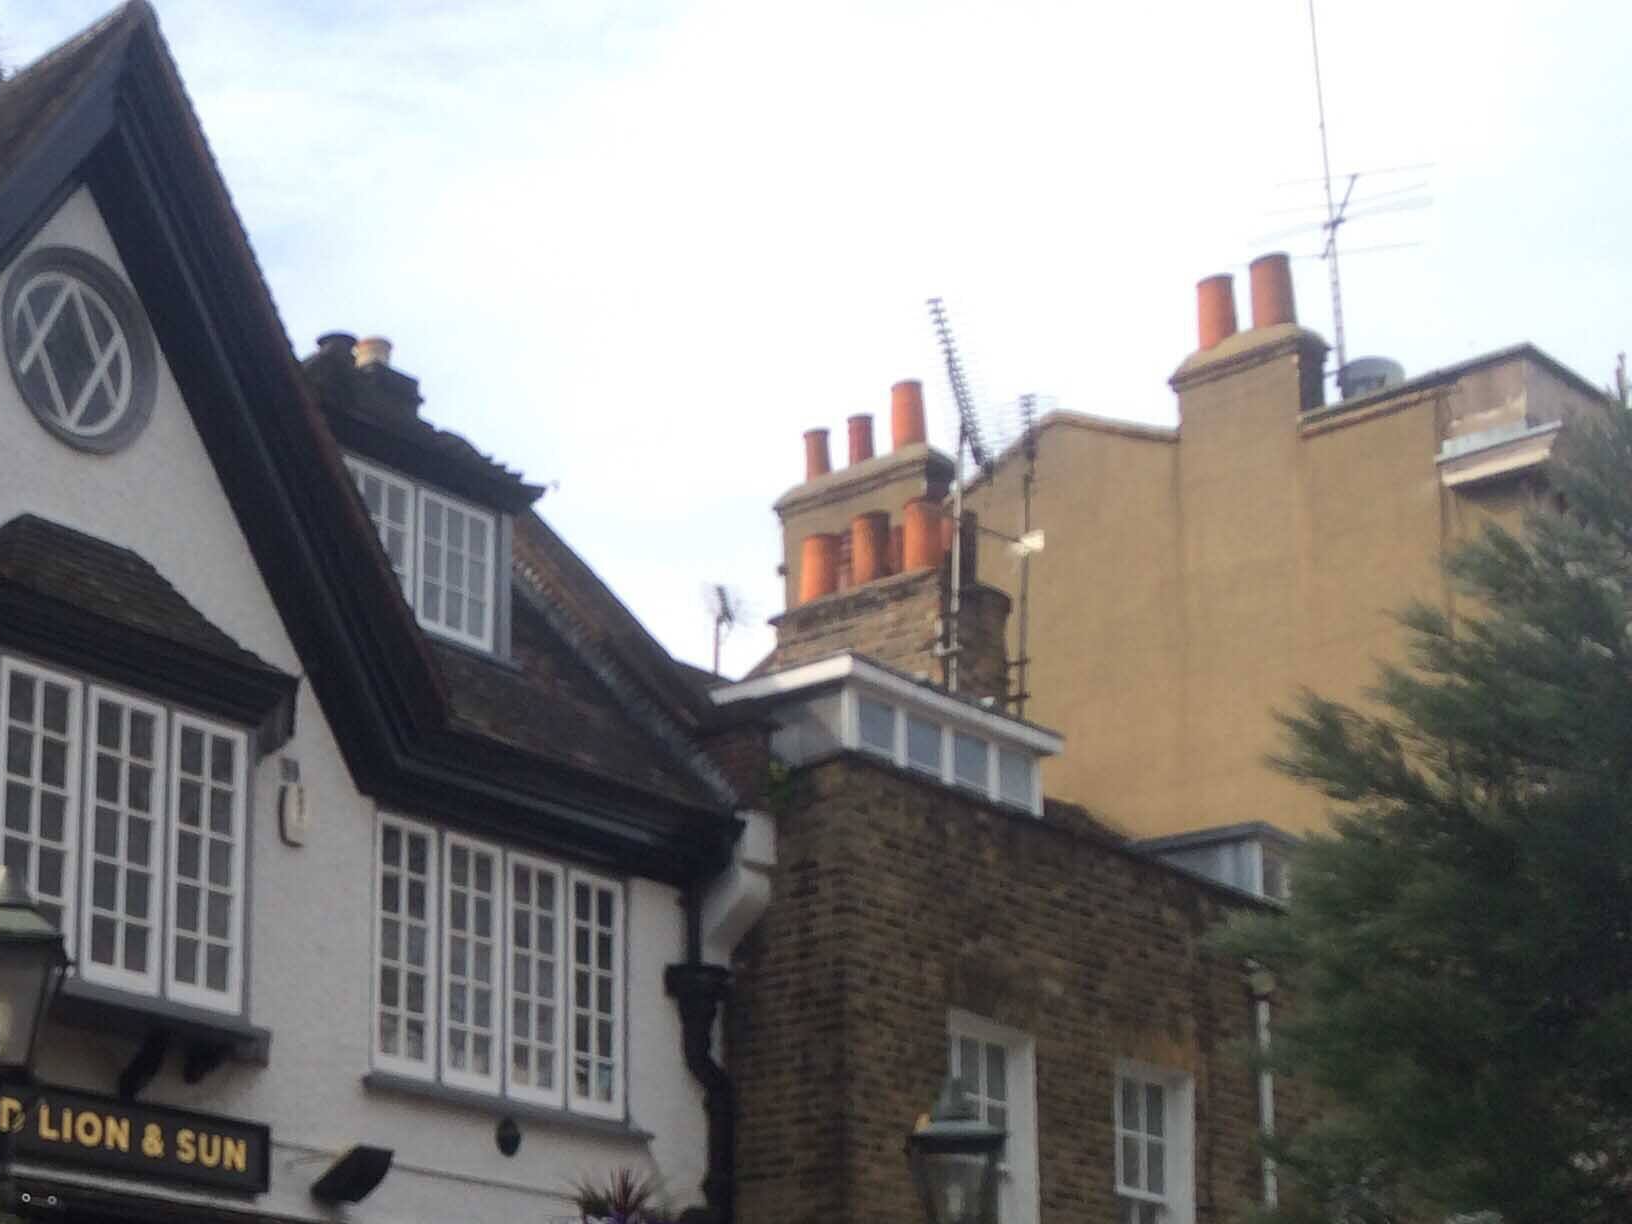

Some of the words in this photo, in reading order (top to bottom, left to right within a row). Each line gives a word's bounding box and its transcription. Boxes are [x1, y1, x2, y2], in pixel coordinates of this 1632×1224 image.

[38, 1103, 131, 1152] LION
[141, 1122, 165, 1159] &
[176, 1128, 248, 1172] SUN
